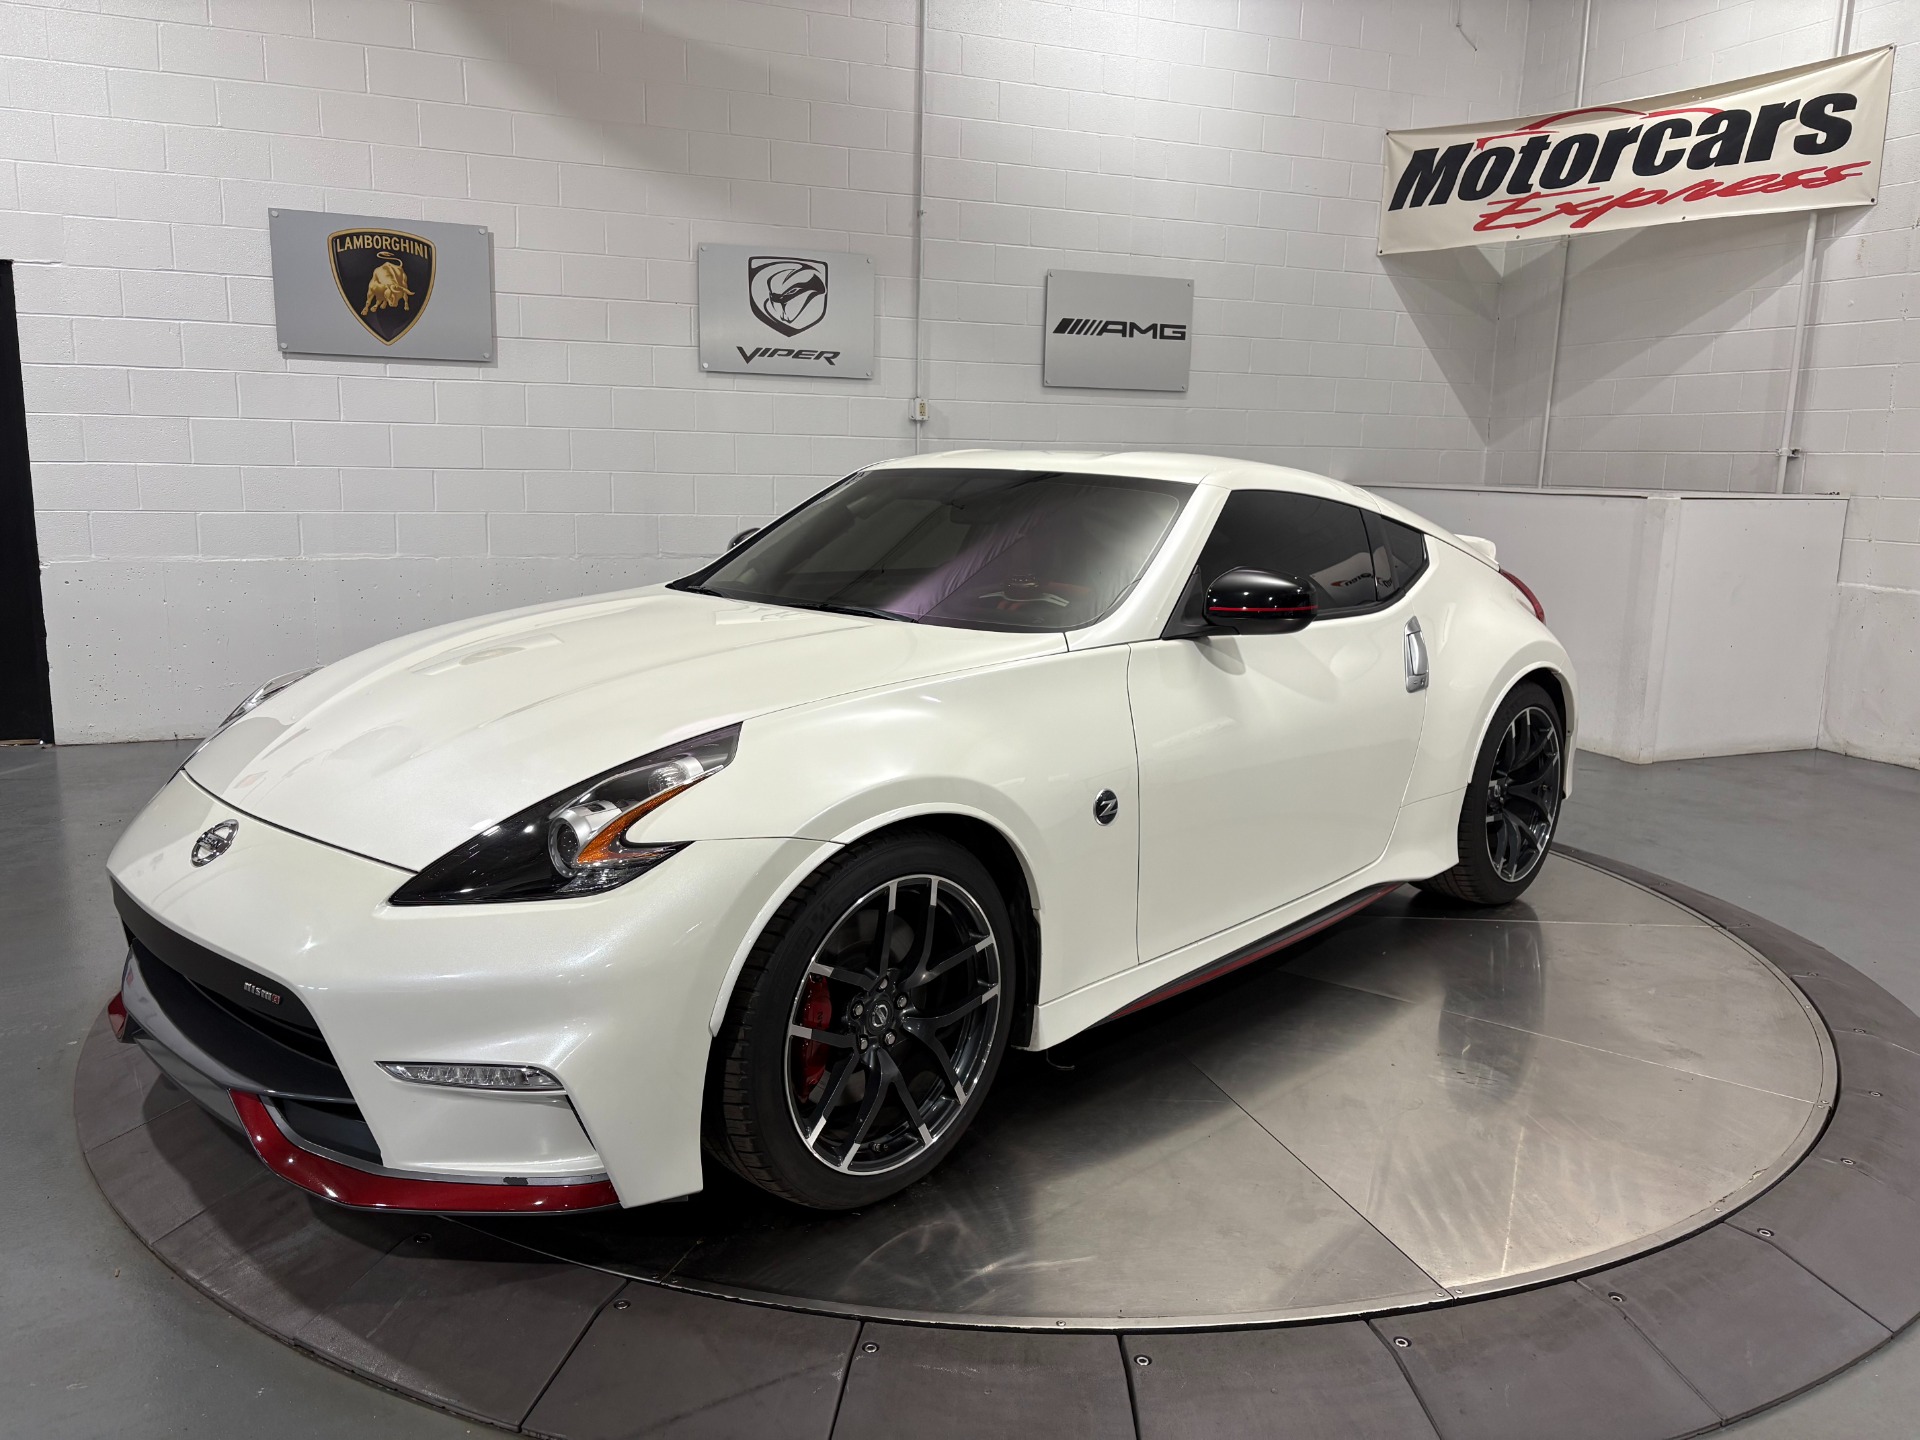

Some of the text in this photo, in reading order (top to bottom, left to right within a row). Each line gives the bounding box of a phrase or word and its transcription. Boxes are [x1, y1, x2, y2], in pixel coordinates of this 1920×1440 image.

[1388, 93, 1857, 211] Motorcars
[1472, 160, 1871, 232] Express
[336, 235, 428, 259] LAMBORGHINI
[736, 346, 840, 366] VIPER
